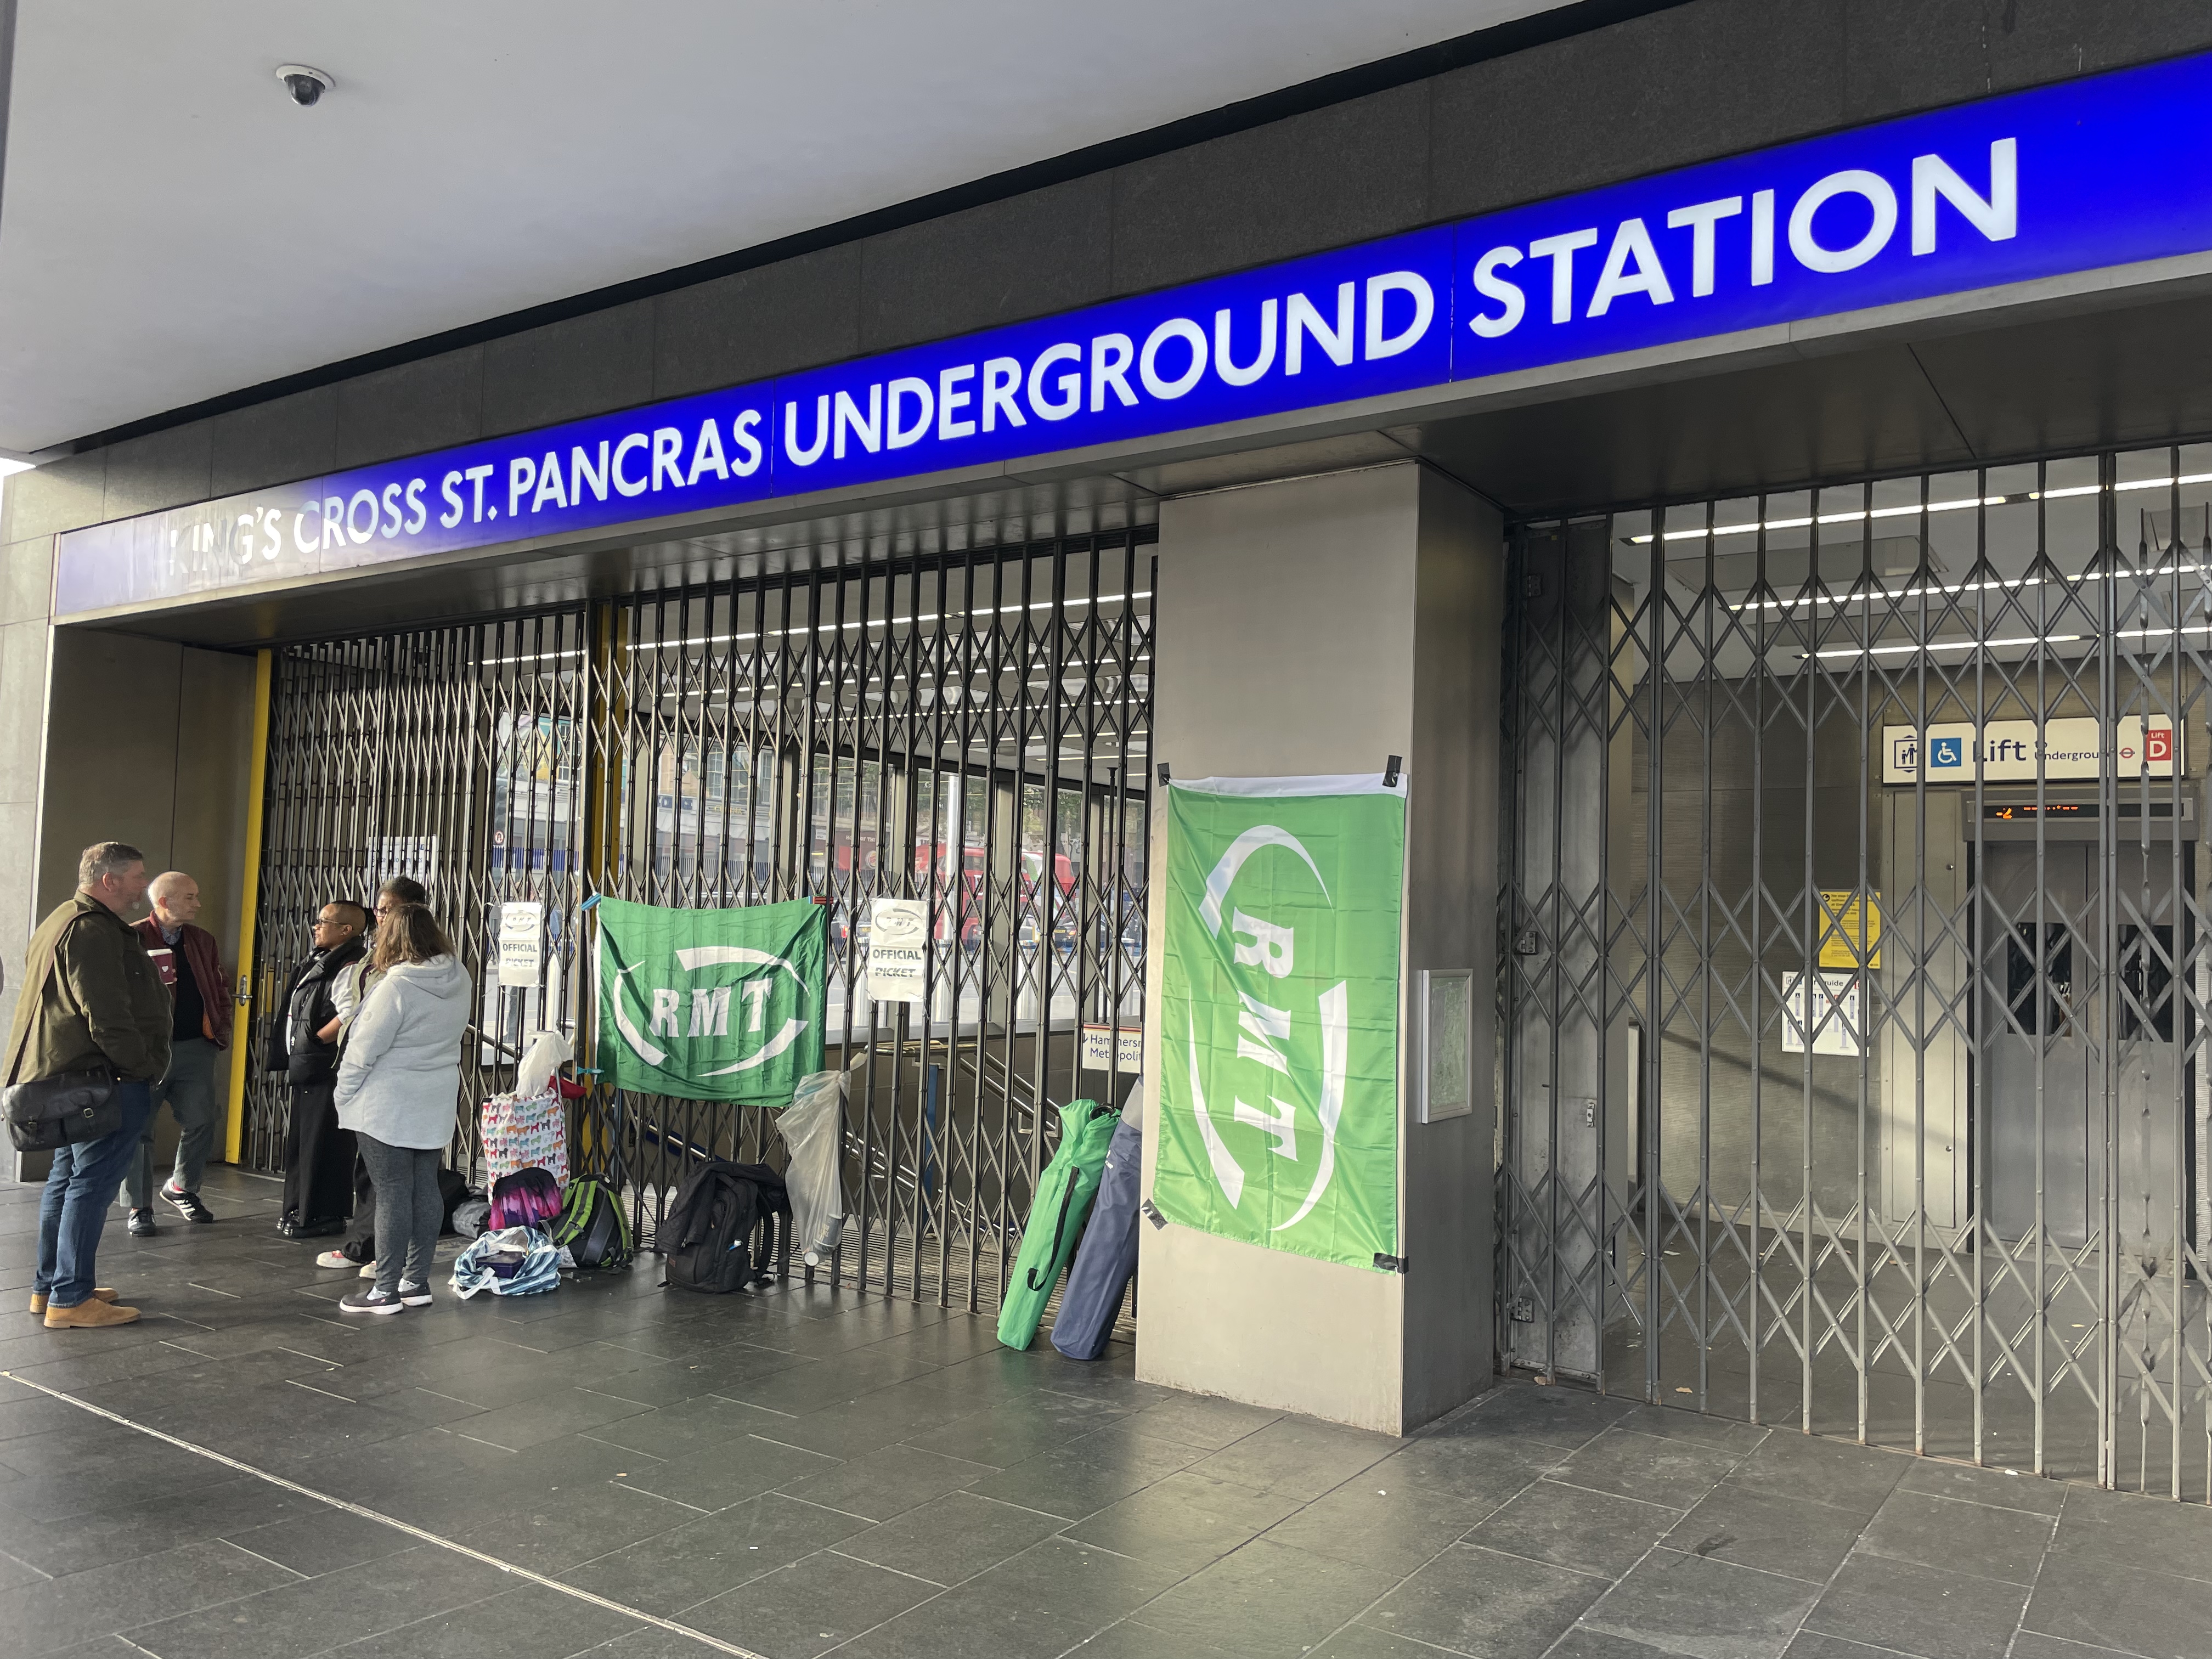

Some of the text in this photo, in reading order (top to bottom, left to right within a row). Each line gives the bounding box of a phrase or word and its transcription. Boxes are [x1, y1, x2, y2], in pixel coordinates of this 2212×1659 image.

[169, 137, 2017, 575] KING'S CROSS ST. PANCRAS UNDERGROUND STATION
[2035, 751, 2109, 761] ndergrou
[2149, 740, 2167, 758] D
[503, 943, 537, 952] OFFICIAL
[872, 949, 922, 960] OFFICIAL
[874, 967, 916, 978] PICKET
[648, 978, 773, 1038] RMT
[1231, 905, 1300, 1163] RMT
